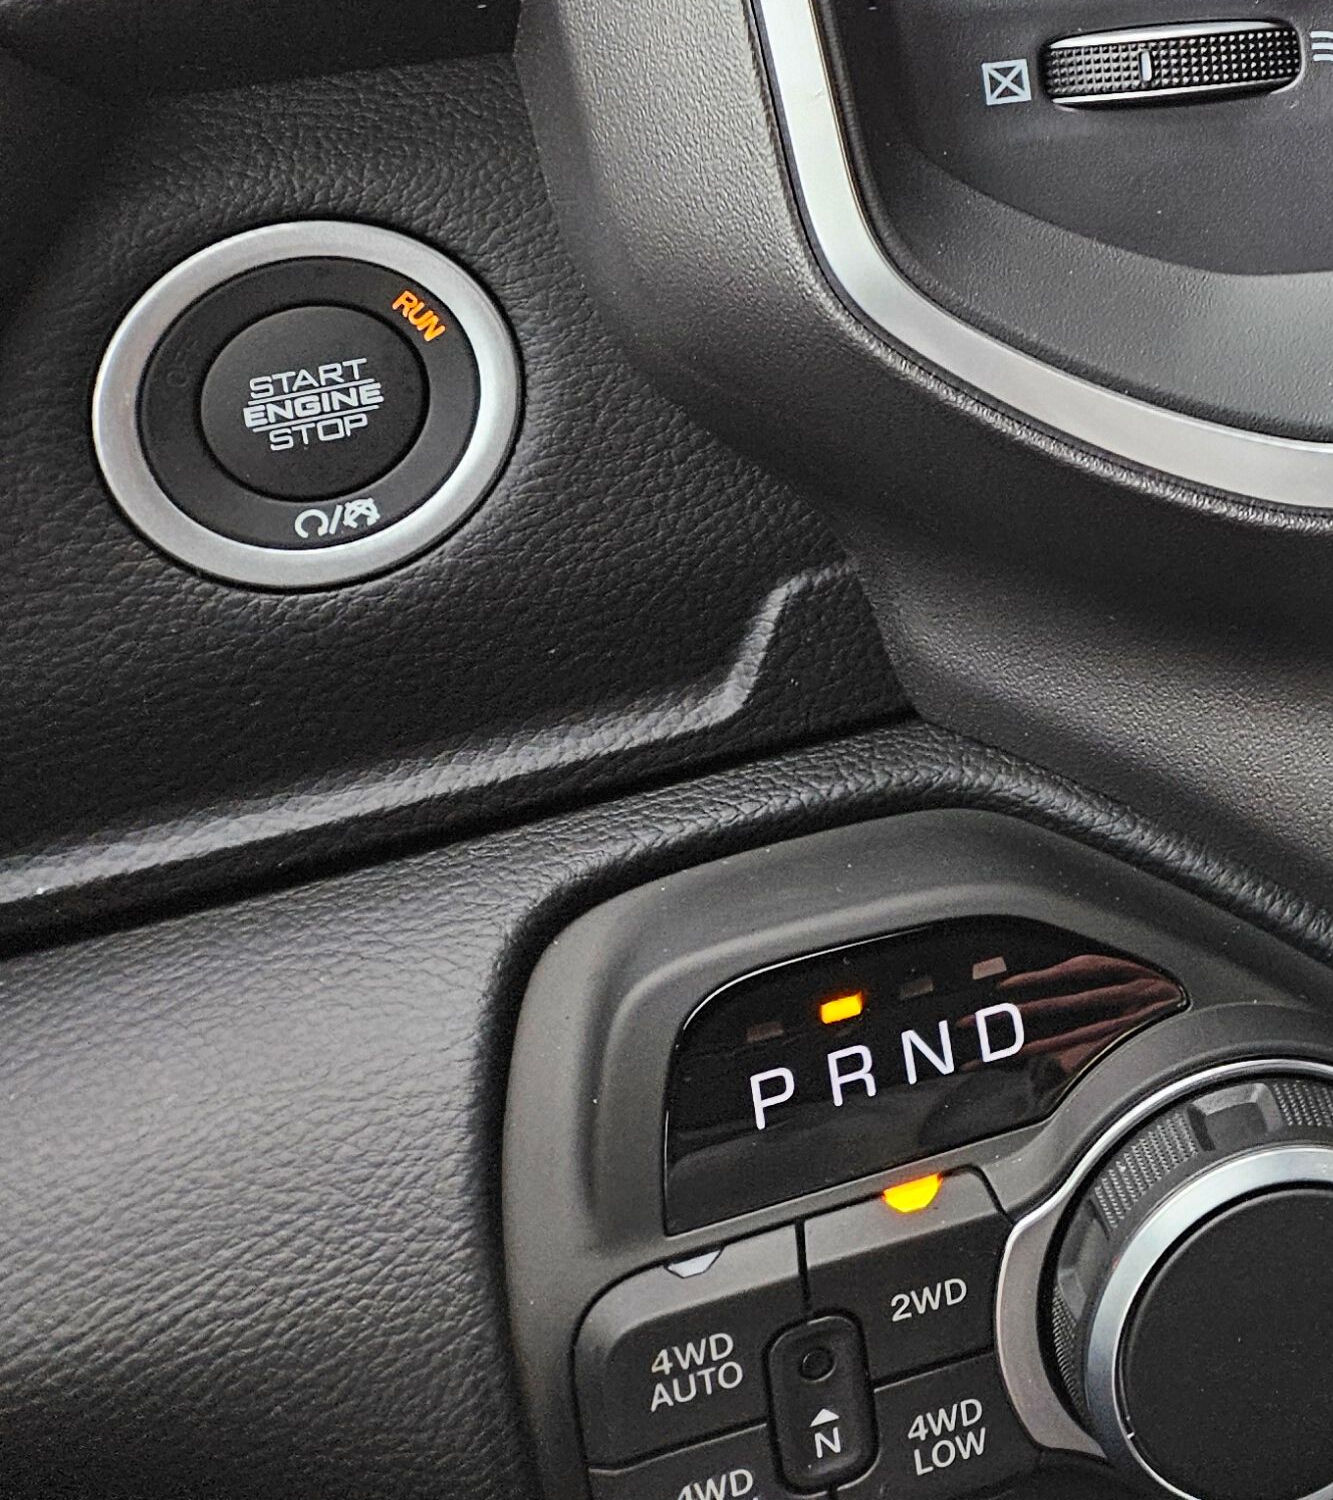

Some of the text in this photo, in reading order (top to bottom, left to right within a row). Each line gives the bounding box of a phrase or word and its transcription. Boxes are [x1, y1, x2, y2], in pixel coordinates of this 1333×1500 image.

[392, 290, 446, 342] RUN
[249, 358, 368, 400] START
[243, 382, 384, 428] ENGINE
[269, 413, 368, 451] STOP
[750, 1002, 1026, 1130] P R N D
[891, 1278, 968, 1321] 2WD
[651, 1332, 734, 1376] 4WD
[650, 1361, 743, 1412] AUTO
[907, 1398, 983, 1441] 4WD
[814, 1427, 841, 1458] N
[913, 1427, 987, 1476] LOW
